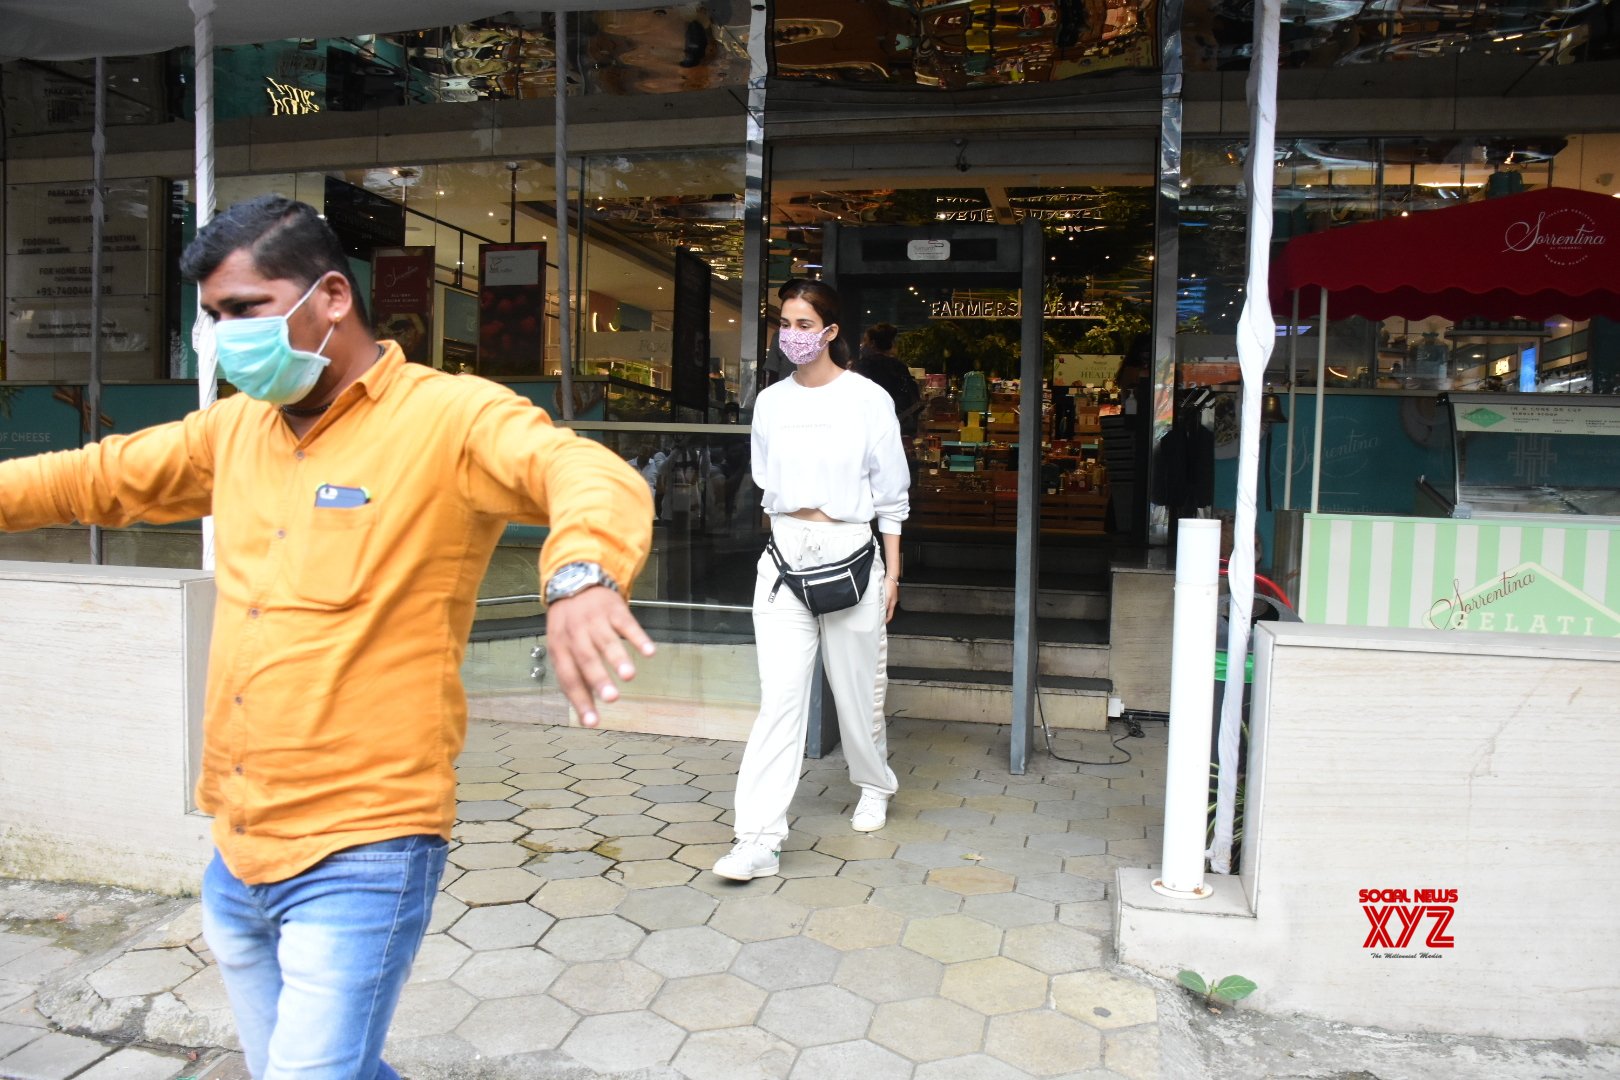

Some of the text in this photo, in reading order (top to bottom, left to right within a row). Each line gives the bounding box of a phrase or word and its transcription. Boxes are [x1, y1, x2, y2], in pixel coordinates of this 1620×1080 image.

[1501, 211, 1605, 253] Sorrentina
[931, 301, 1104, 317] FARMERS ARKET
[11, 432, 51, 442] CHEESE
[1430, 571, 1536, 631] Sorrentina
[1451, 611, 1594, 635] GELATI
